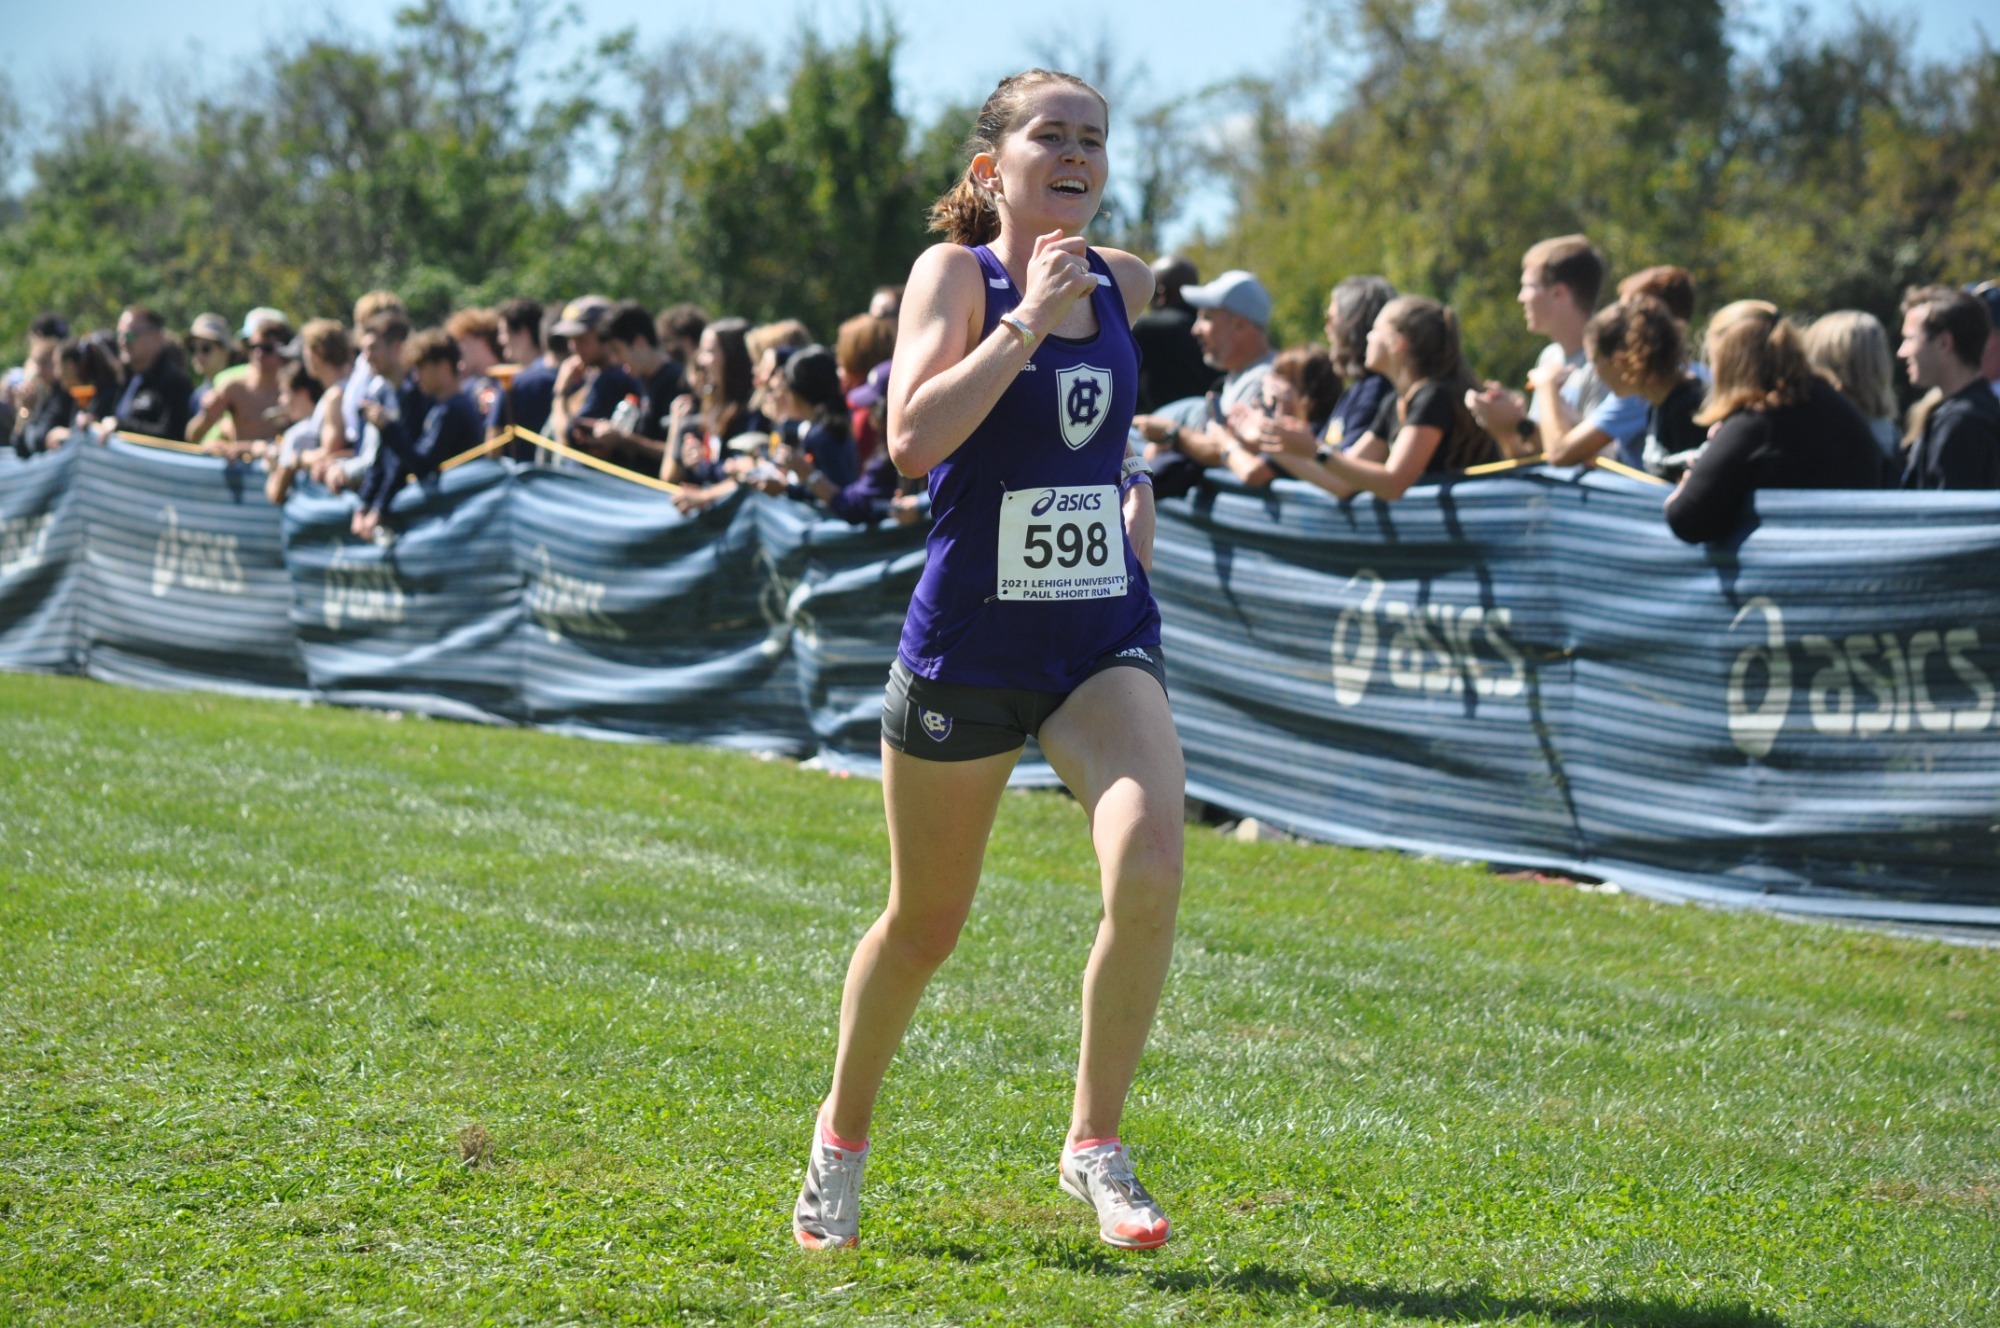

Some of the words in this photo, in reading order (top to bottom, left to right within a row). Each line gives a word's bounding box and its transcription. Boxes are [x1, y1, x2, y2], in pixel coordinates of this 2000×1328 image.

[1023, 522, 1108, 569] 598
[1002, 580, 1028, 588] 2021
[1032, 579, 1072, 588] LEHIGH
[1074, 575, 1126, 587] UNIVERSITY
[1023, 591, 1053, 599] PAUL
[1055, 589, 1089, 598] SHORT
[1091, 588, 1111, 597] RUN
